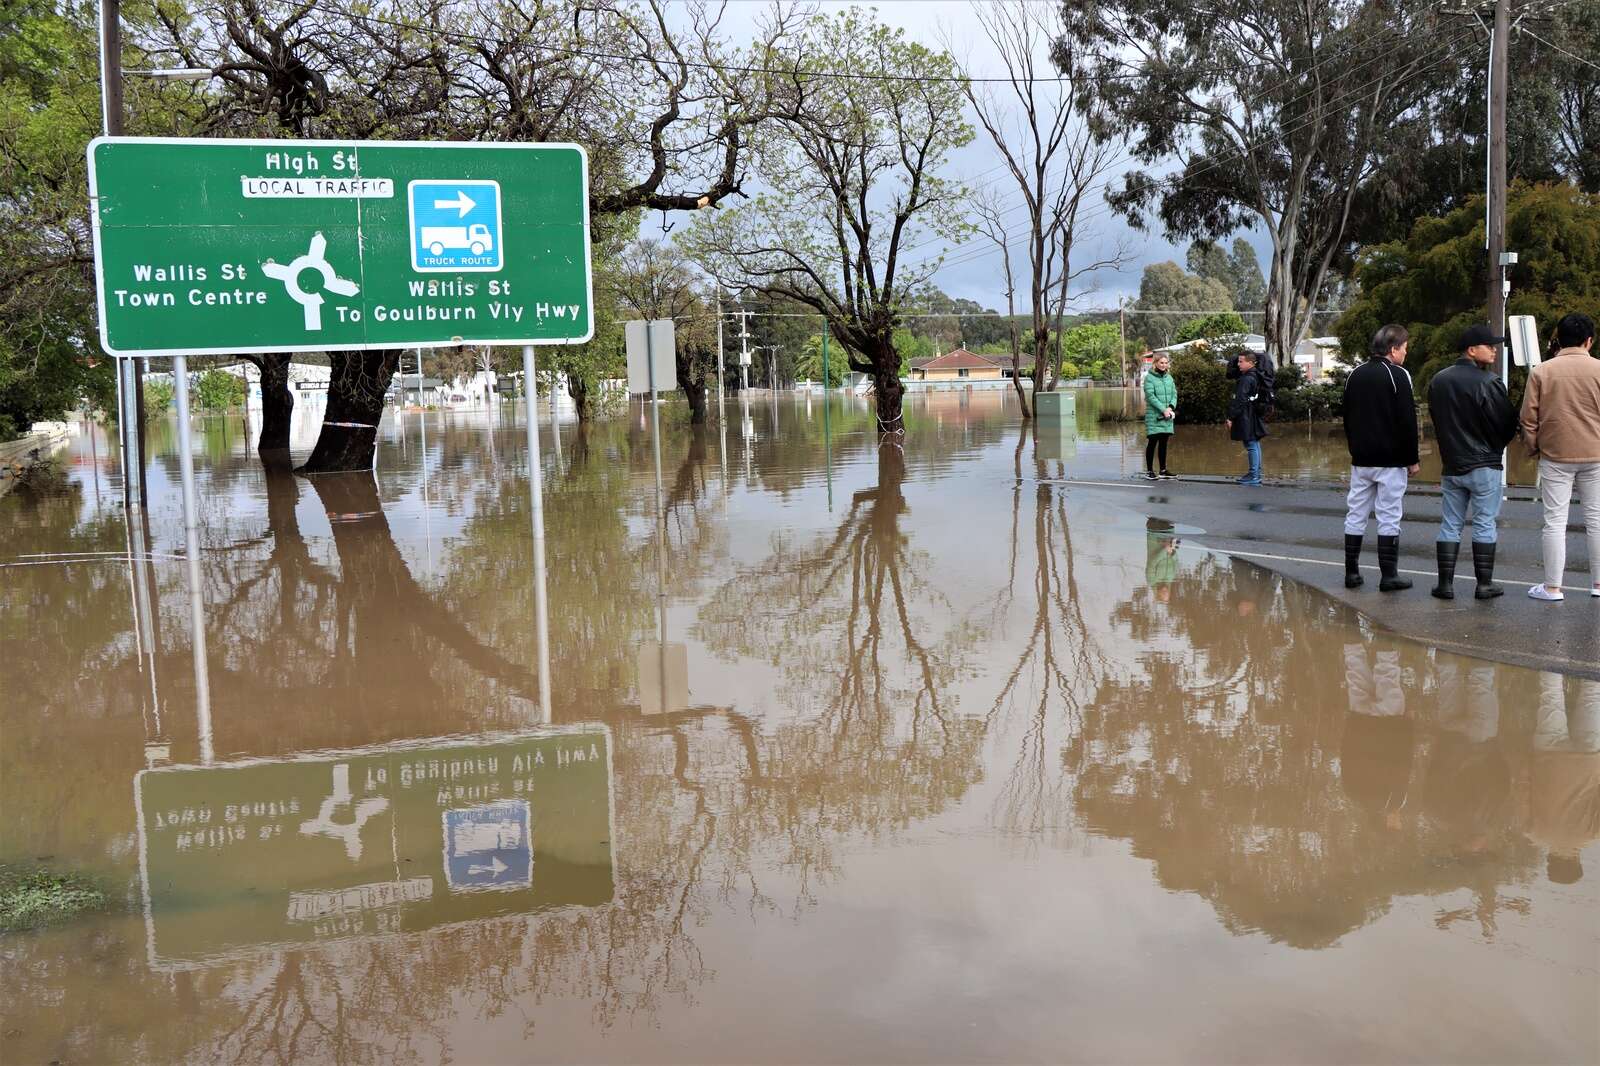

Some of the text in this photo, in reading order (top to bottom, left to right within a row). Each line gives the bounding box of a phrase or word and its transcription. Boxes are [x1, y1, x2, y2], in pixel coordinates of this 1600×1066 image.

[265, 151, 358, 175] High St
[248, 181, 388, 195] LOCAL TRAFFIC
[423, 257, 494, 265] TRUCK ROUTE
[134, 263, 247, 282] Wallis St
[114, 288, 268, 307] Town Centre
[408, 279, 511, 297] Wallis St
[335, 302, 580, 323] To Goulburn Vly Hwy
